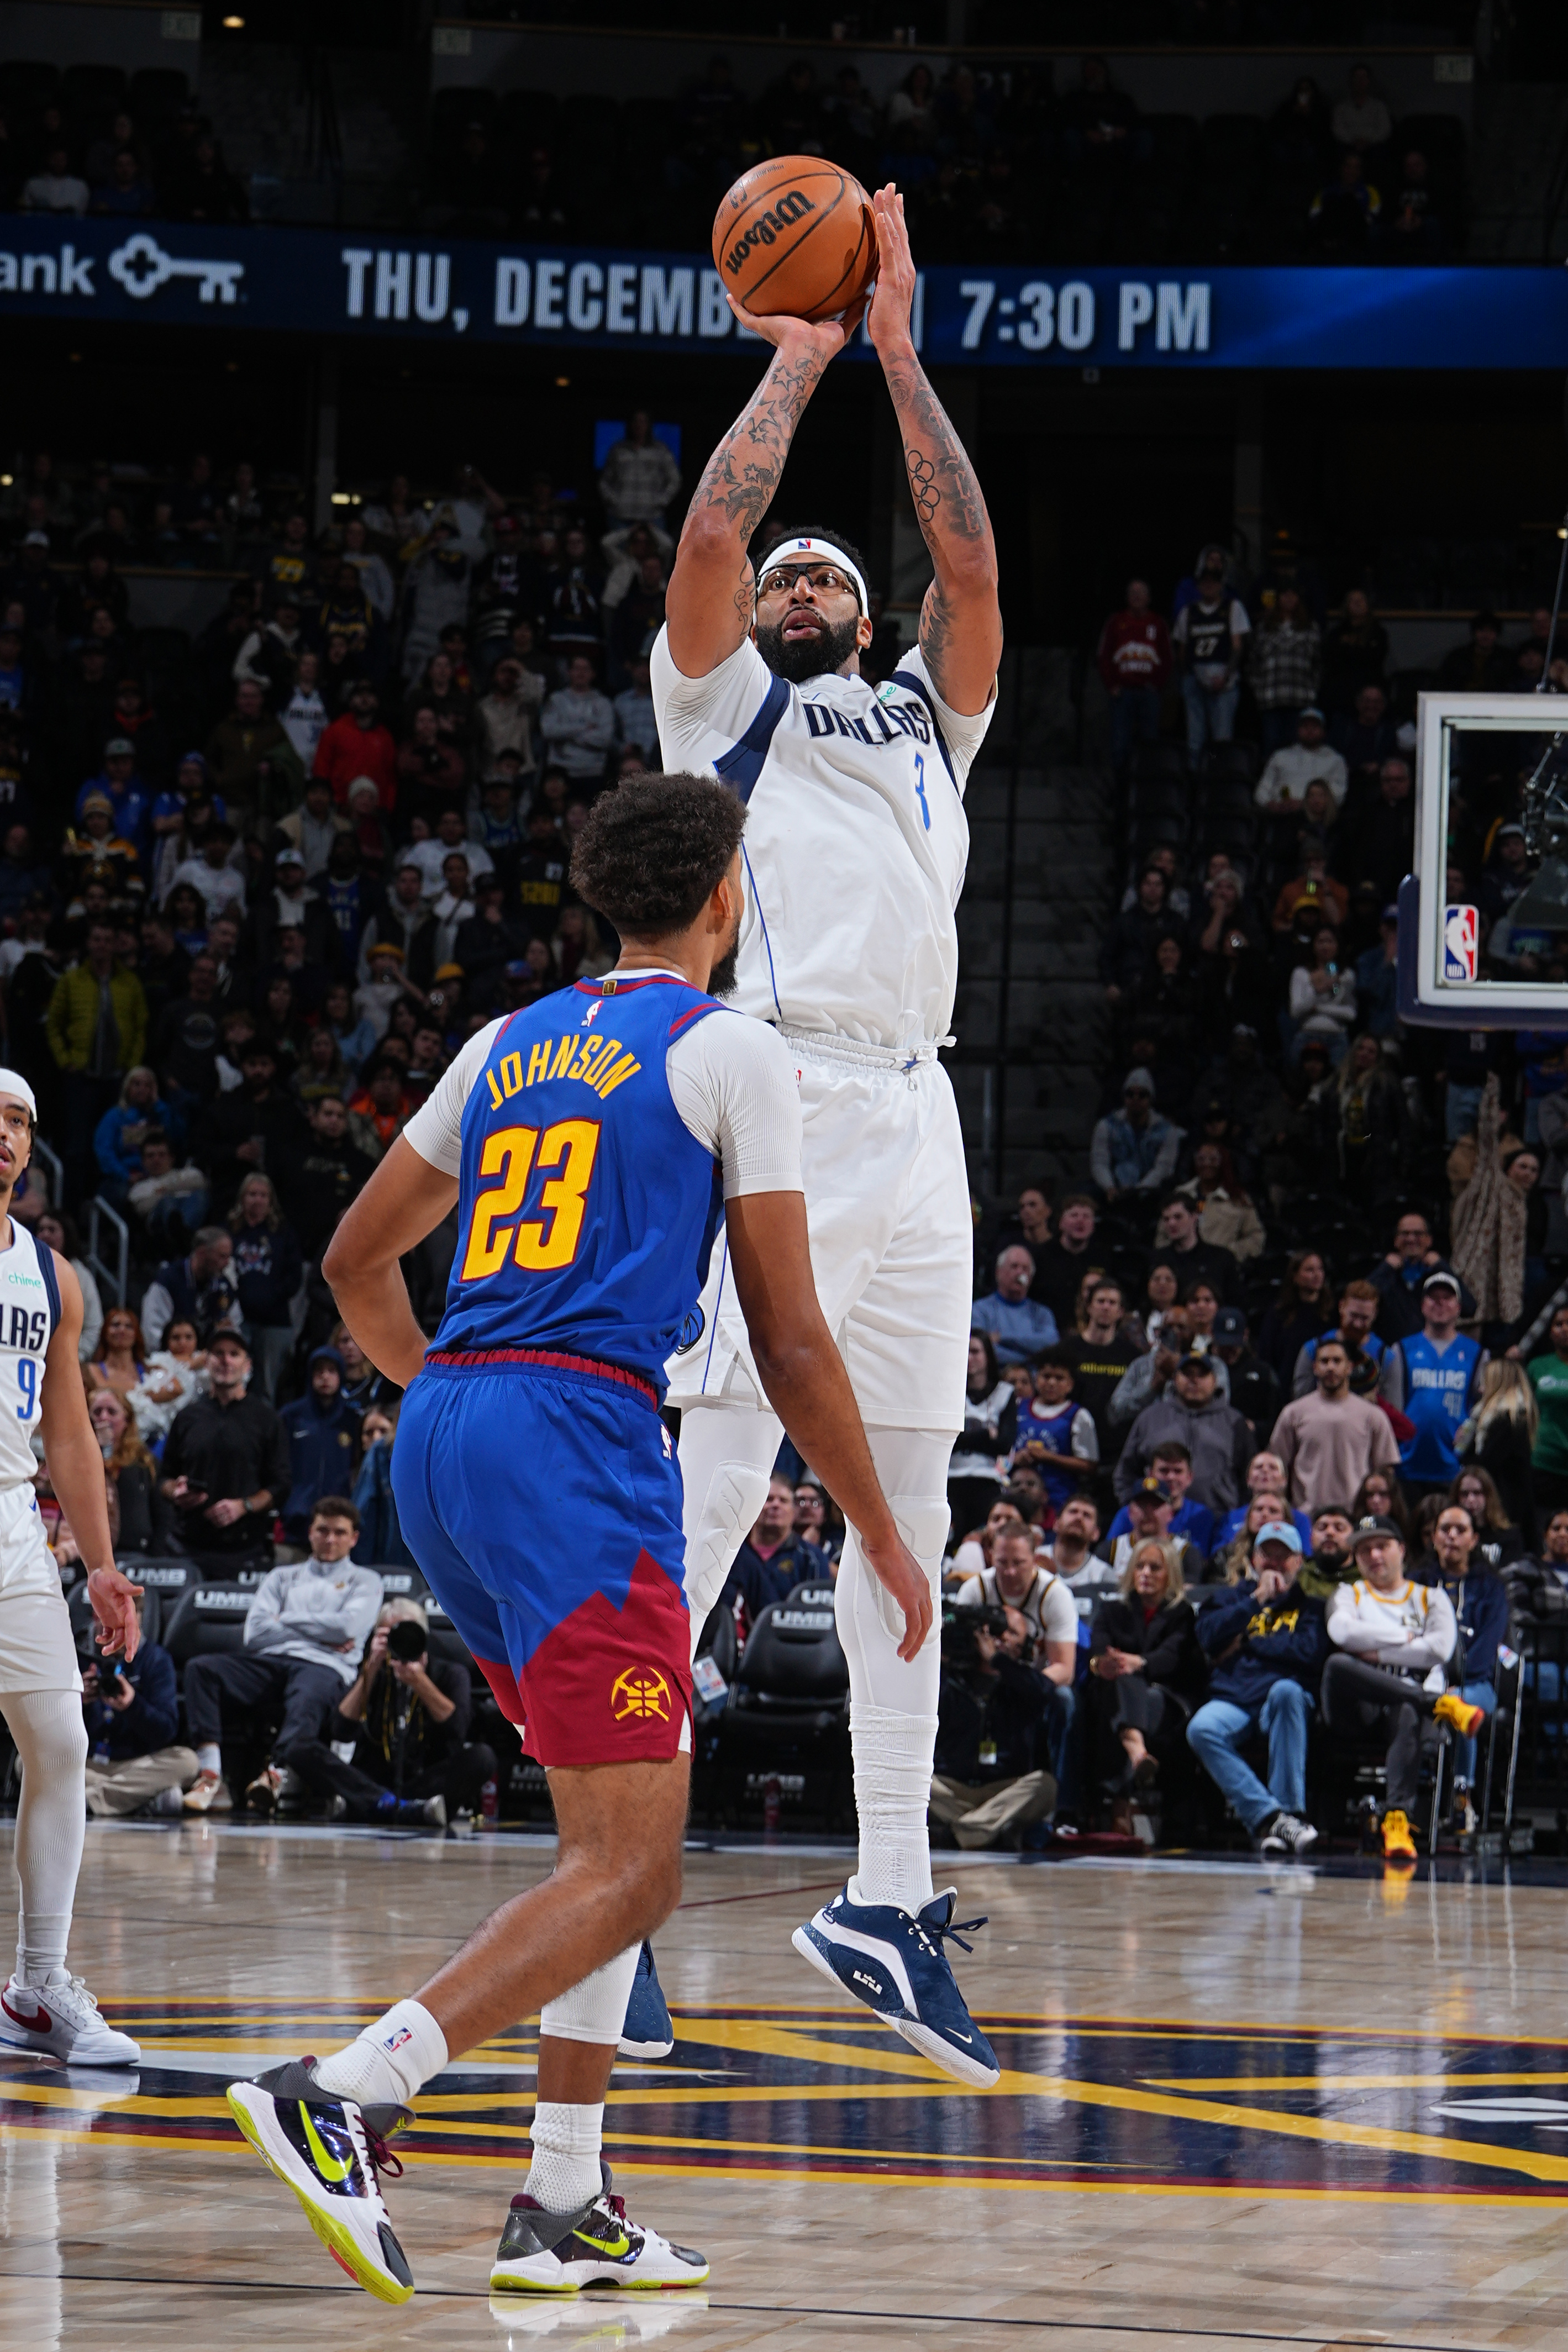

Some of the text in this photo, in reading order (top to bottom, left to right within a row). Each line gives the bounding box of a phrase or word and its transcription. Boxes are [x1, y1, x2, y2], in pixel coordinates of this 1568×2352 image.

[725, 190, 818, 275] Wilson
[341, 247, 469, 333] THU,
[495, 257, 767, 340] DECEMB
[960, 280, 1095, 351] 7:30
[1118, 281, 1211, 352] PM
[801, 701, 932, 746] DALLAS
[486, 1034, 641, 1111] JOHNSON
[460, 1117, 602, 1282] 23
[8, 1272, 42, 1288] chime
[17, 1357, 35, 1420] 9
[126, 1567, 187, 1586] UMB
[801, 1589, 835, 1605] UM
[771, 1609, 834, 1630] UMB
